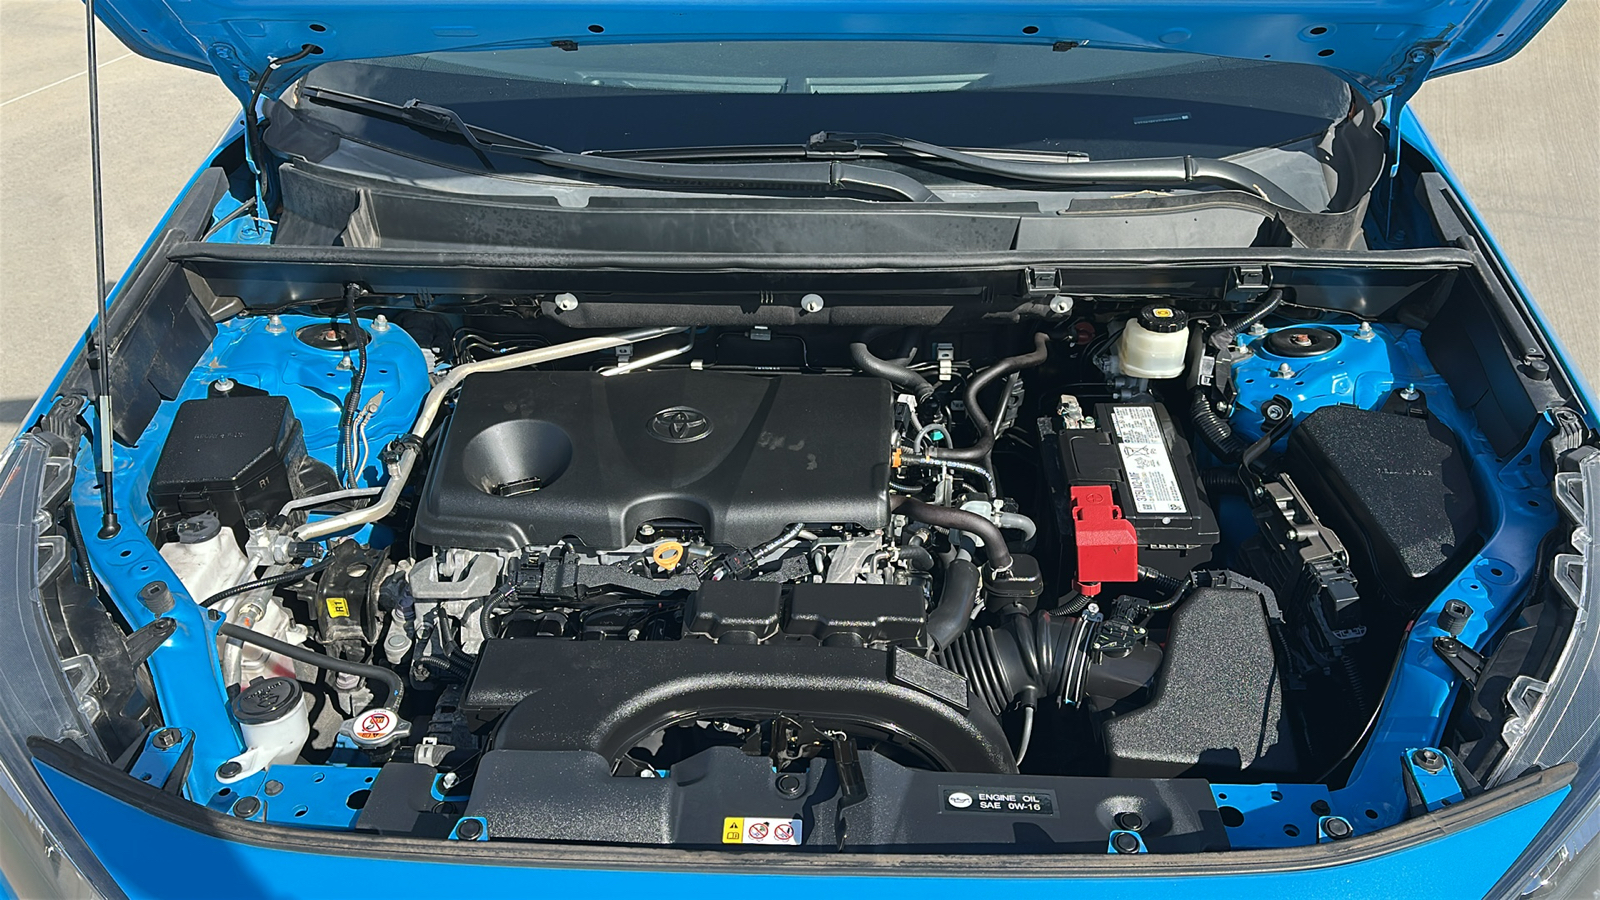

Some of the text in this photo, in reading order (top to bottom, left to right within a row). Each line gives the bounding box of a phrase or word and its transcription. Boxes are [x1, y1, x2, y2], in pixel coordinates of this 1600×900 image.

[259, 476, 270, 488] R1
[335, 602, 344, 612] R1
[979, 793, 1016, 802] ENGINE
[979, 802, 1041, 811] SAE 0W-16
